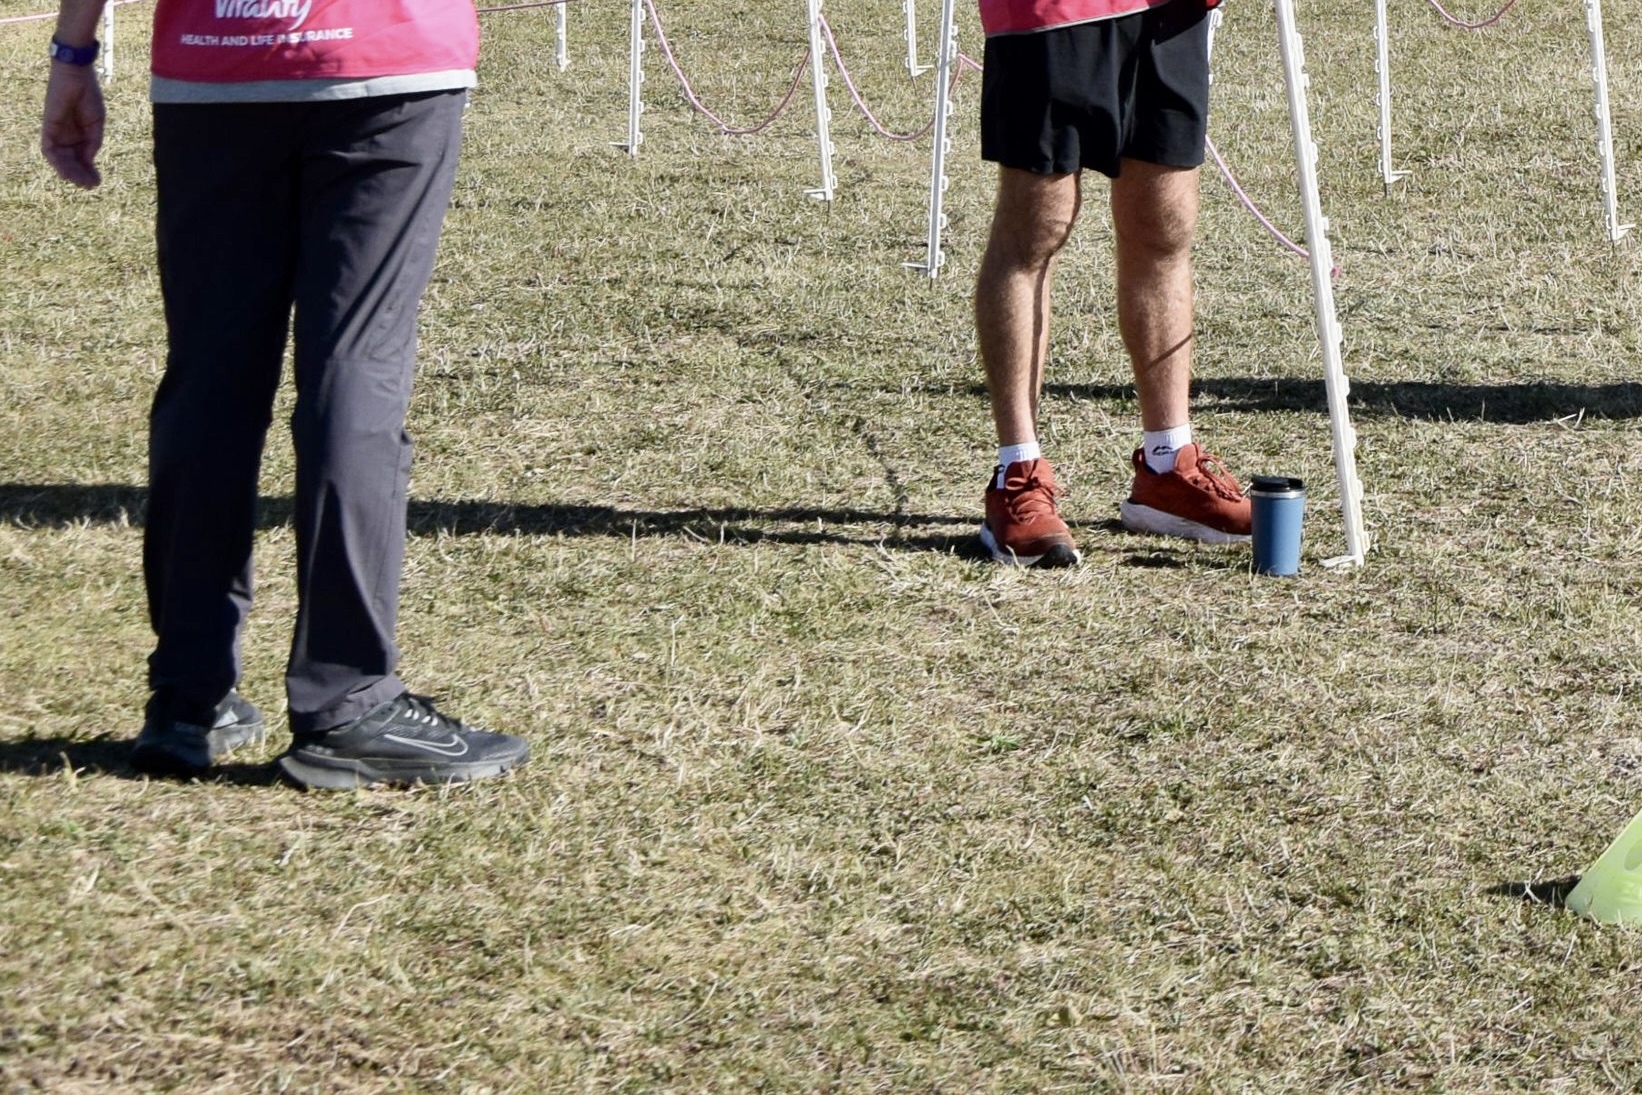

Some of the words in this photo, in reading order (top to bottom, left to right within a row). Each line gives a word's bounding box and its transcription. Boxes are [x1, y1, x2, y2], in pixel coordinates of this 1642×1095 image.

[181, 33, 219, 46] HEALTH
[221, 35, 248, 47] AND
[250, 34, 275, 46] LIFE
